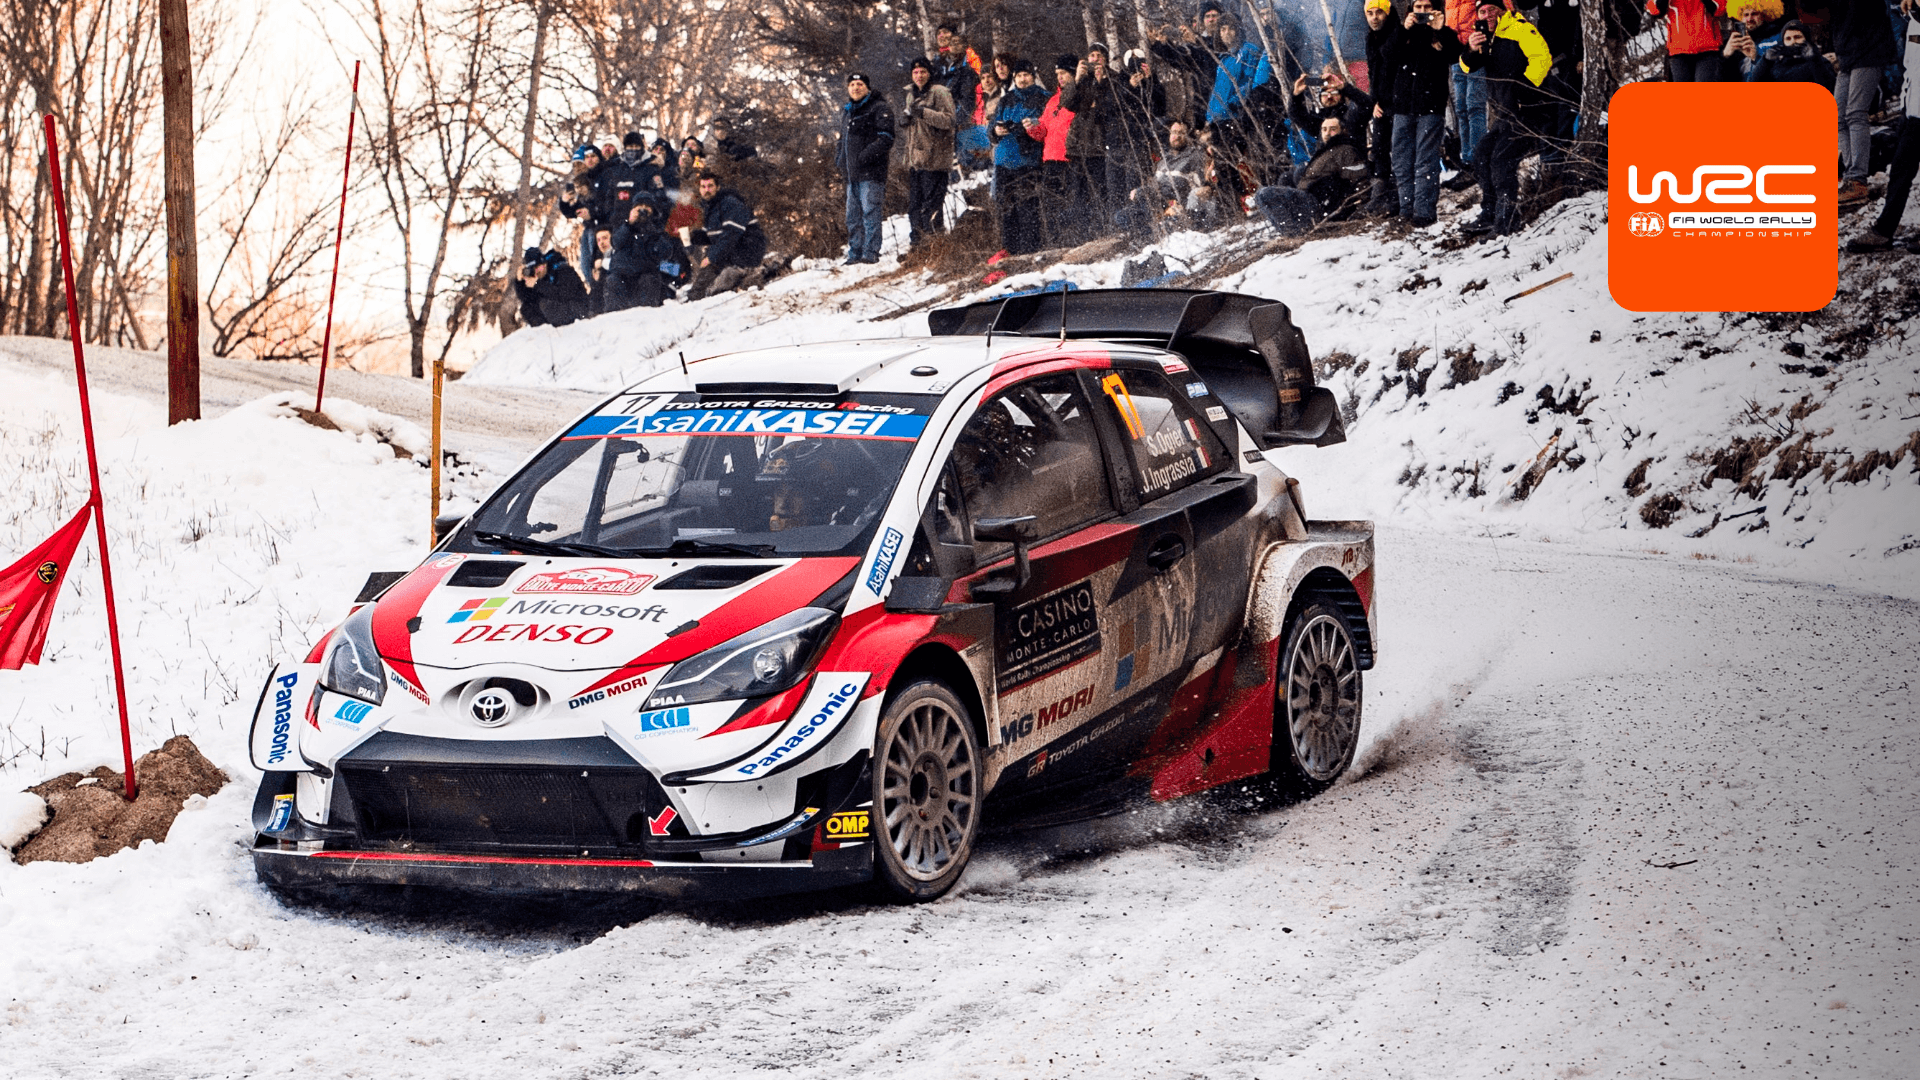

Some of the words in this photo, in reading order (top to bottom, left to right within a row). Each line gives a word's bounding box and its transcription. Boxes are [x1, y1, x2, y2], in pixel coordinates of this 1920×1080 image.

[620, 394, 655, 415] 17
[665, 401, 750, 411] TOYOTA
[838, 402, 915, 415] Racing
[507, 600, 668, 622] Microsoft
[1018, 588, 1092, 638] CASINO
[453, 623, 614, 645] DENSO
[357, 685, 377, 700] PIAA
[390, 671, 409, 691] DMG
[408, 685, 431, 706] MORI
[568, 690, 606, 710] DMG
[607, 676, 648, 697] MORI
[650, 694, 686, 708] PIAA
[267, 671, 298, 765] Panasonic
[1000, 714, 1034, 747] MG
[1037, 683, 1095, 730] MORI
[737, 682, 857, 776] Panasonic
[1048, 734, 1090, 765] TOYOTA
[826, 817, 869, 834] OMP
